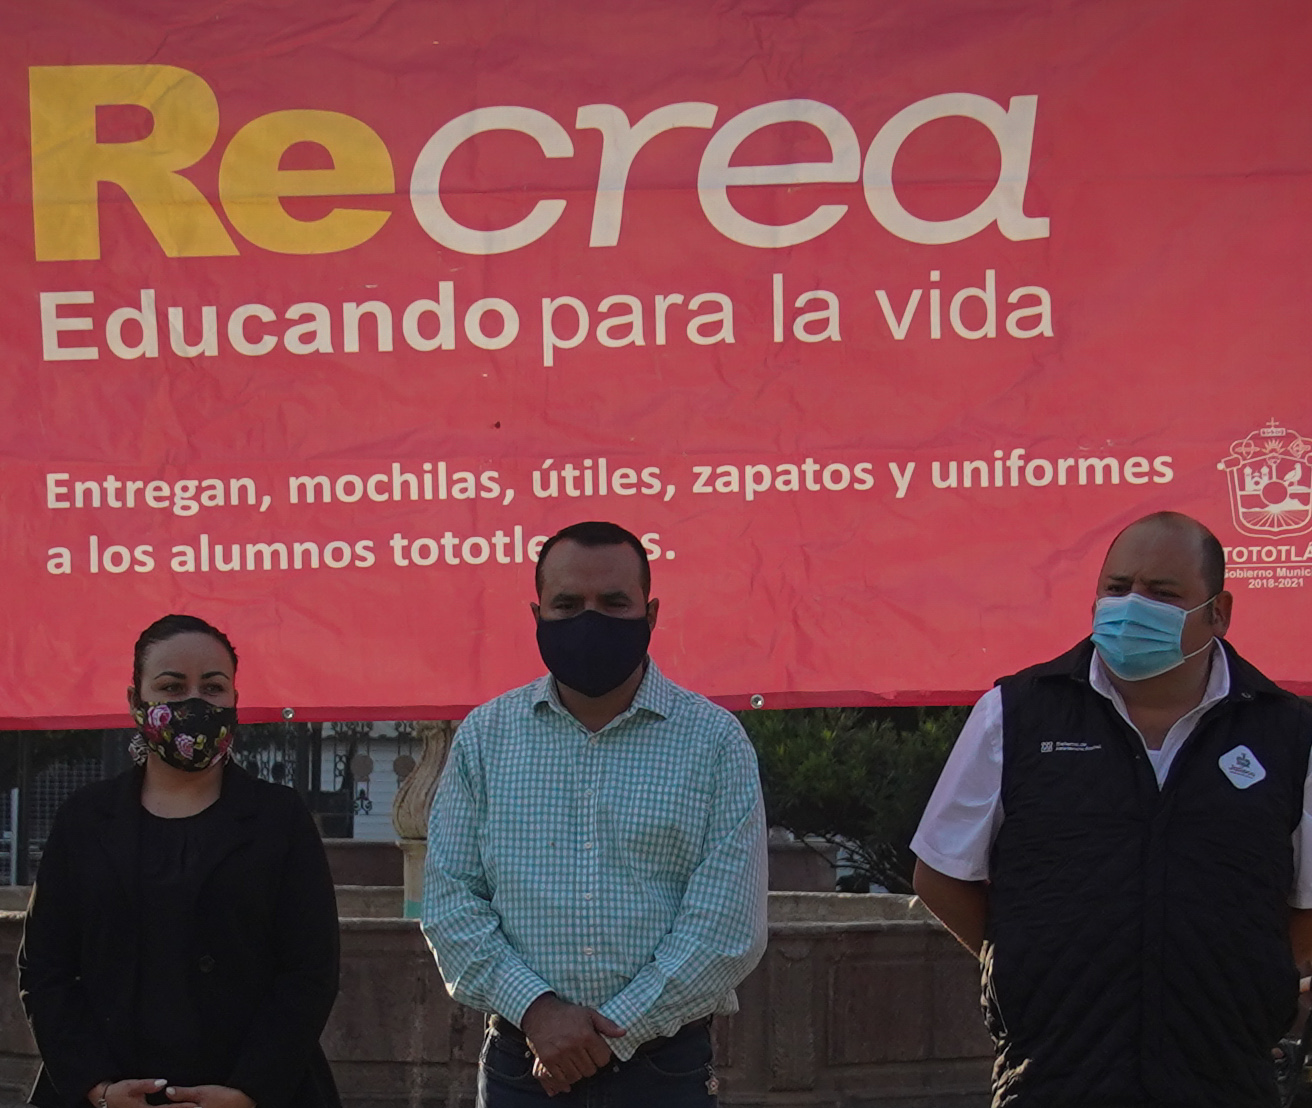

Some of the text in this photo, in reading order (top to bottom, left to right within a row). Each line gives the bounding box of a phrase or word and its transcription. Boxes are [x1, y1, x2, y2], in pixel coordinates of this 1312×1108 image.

[29, 65, 1050, 261] Recrea
[40, 269, 1054, 367] Educando para la vida
[46, 448, 1174, 517] Entregan, mochilas, útiles, zapatos y uniformes
[46, 546, 72, 575] a
[89, 535, 155, 574] los
[170, 534, 376, 573] alumnos
[1248, 578, 1304, 589] 2018-2021
